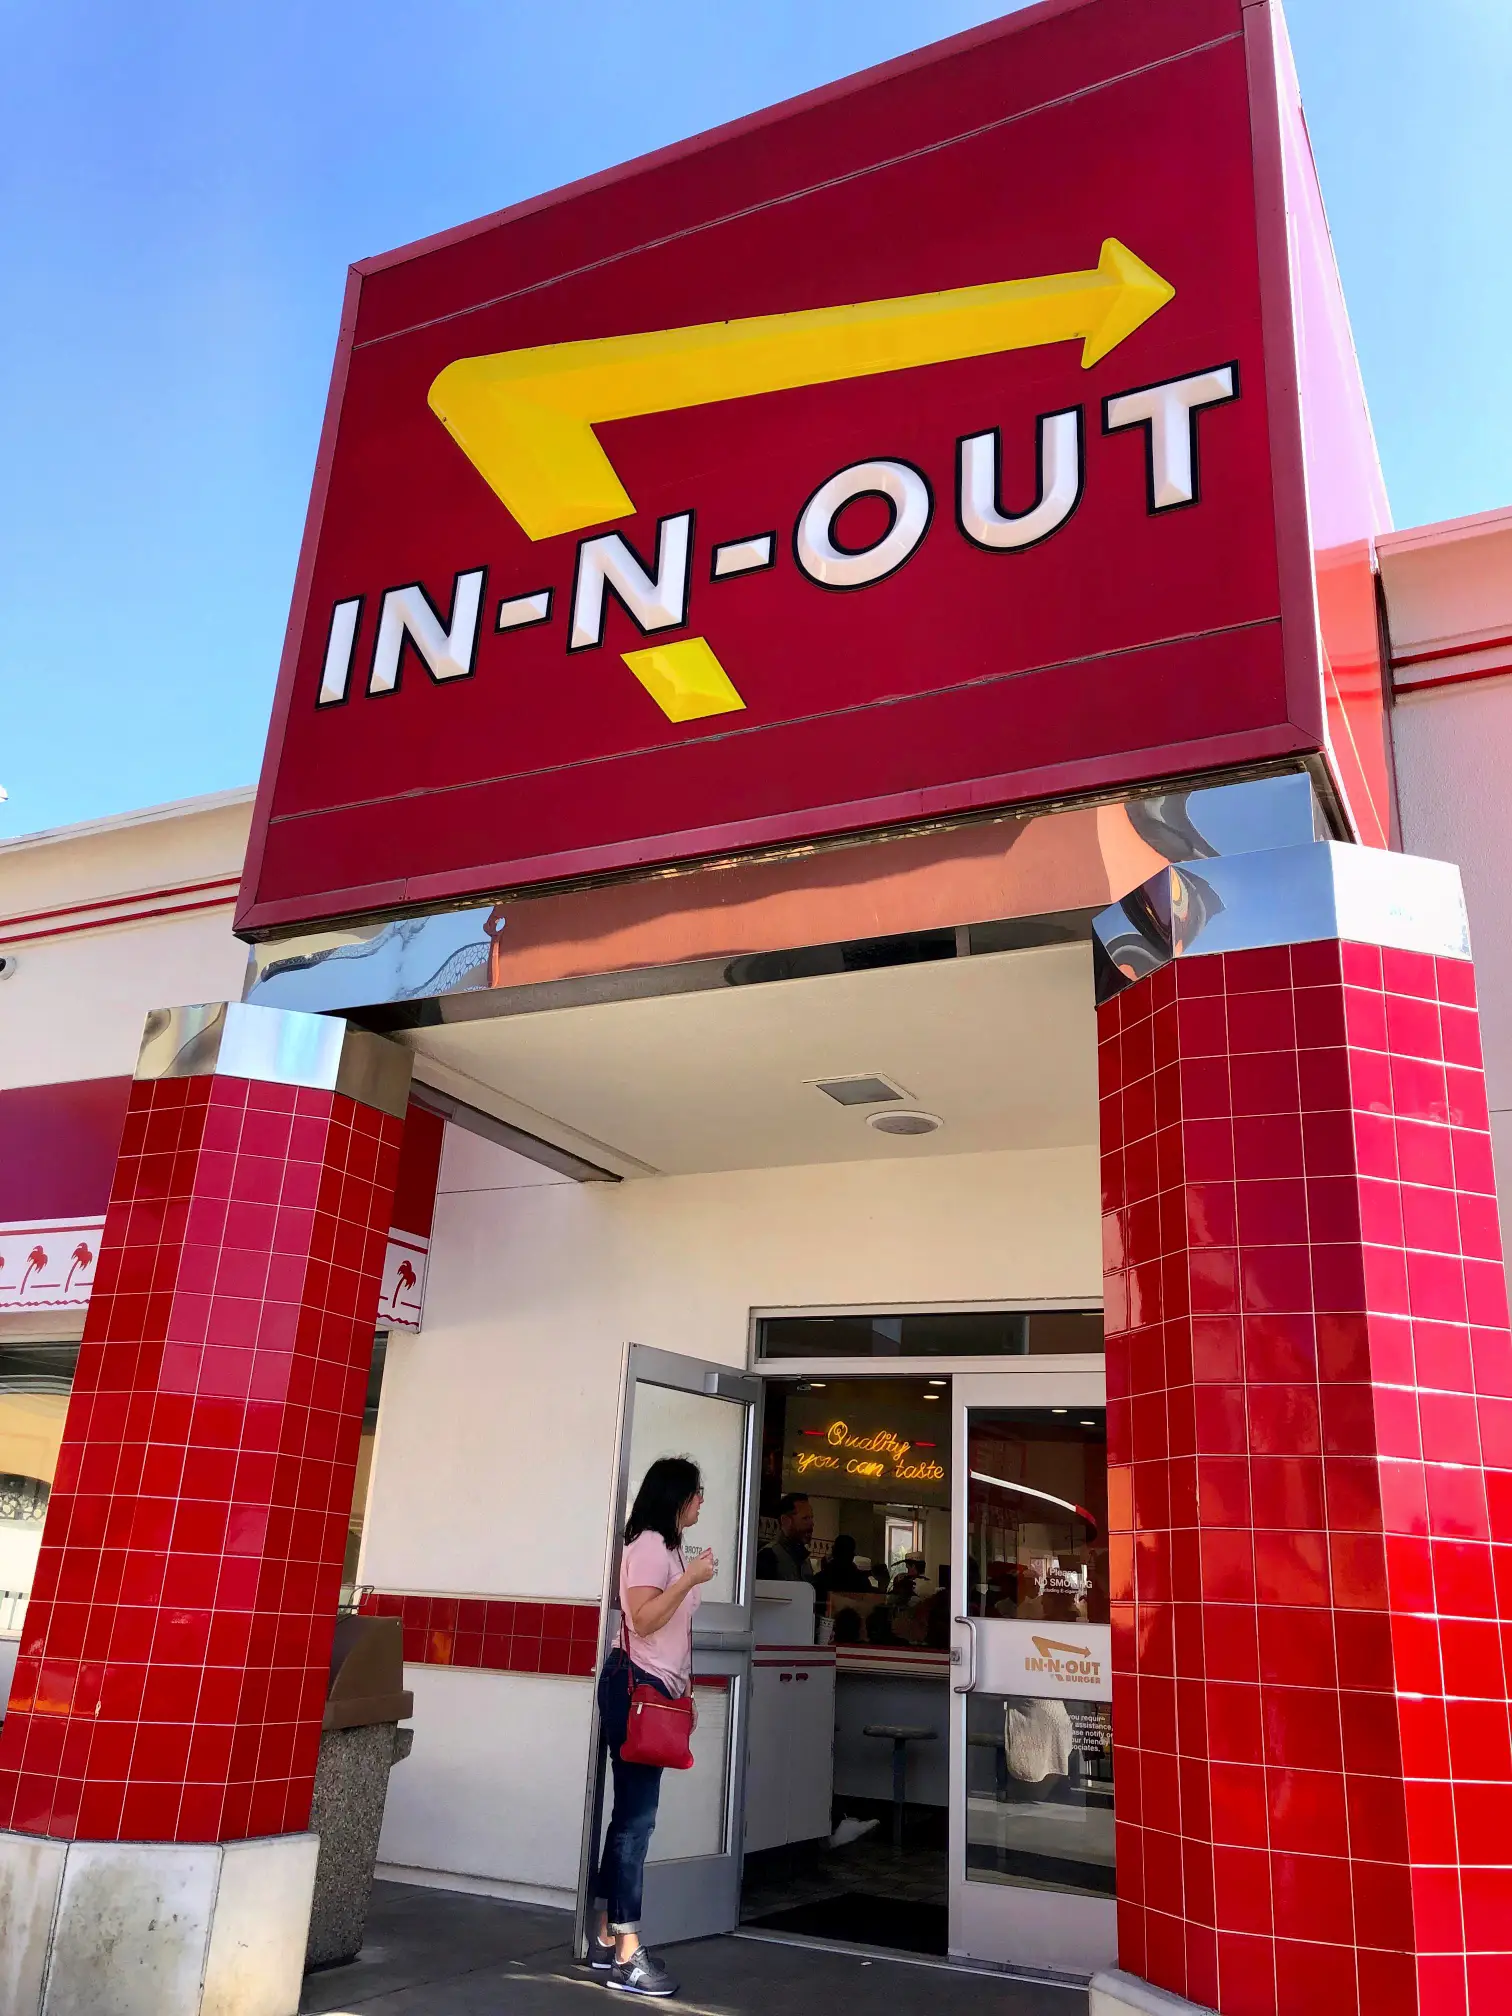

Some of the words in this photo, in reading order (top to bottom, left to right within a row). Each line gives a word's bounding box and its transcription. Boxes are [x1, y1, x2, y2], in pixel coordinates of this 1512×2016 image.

[316, 360, 1240, 709] IN-N-OUT
[827, 1420, 911, 1460] Quality
[797, 1452, 840, 1474] you
[846, 1458, 884, 1478] can
[895, 1459, 945, 1479] taste
[1065, 1674, 1101, 1684] BURGER
[1085, 1730, 1105, 1738] notify
